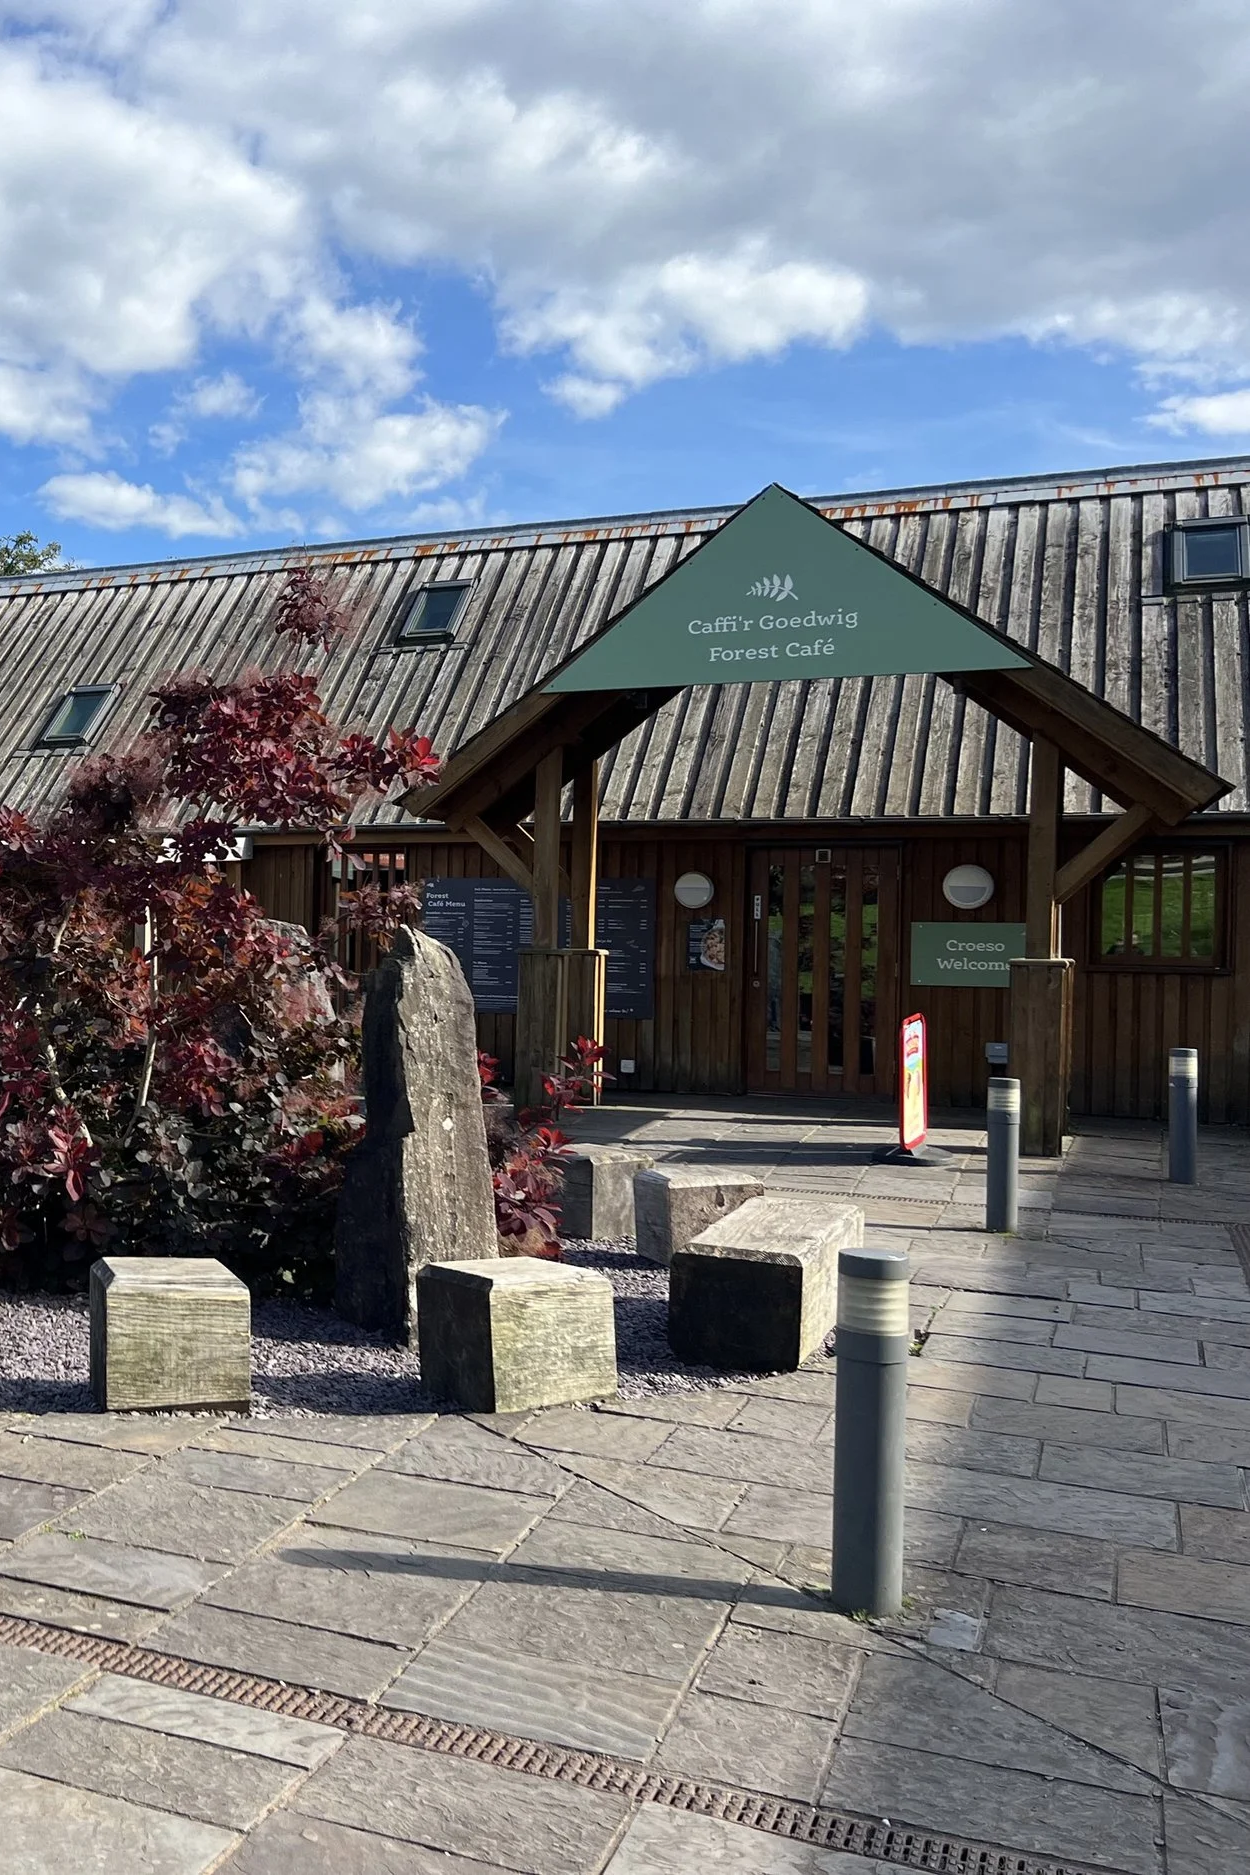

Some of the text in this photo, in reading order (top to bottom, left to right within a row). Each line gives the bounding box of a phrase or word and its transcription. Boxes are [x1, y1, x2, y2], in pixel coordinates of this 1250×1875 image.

[688, 608, 858, 635] Caffi'r Goedwig
[709, 638, 835, 662] Forest Café
[946, 939, 1006, 952] Croeso
